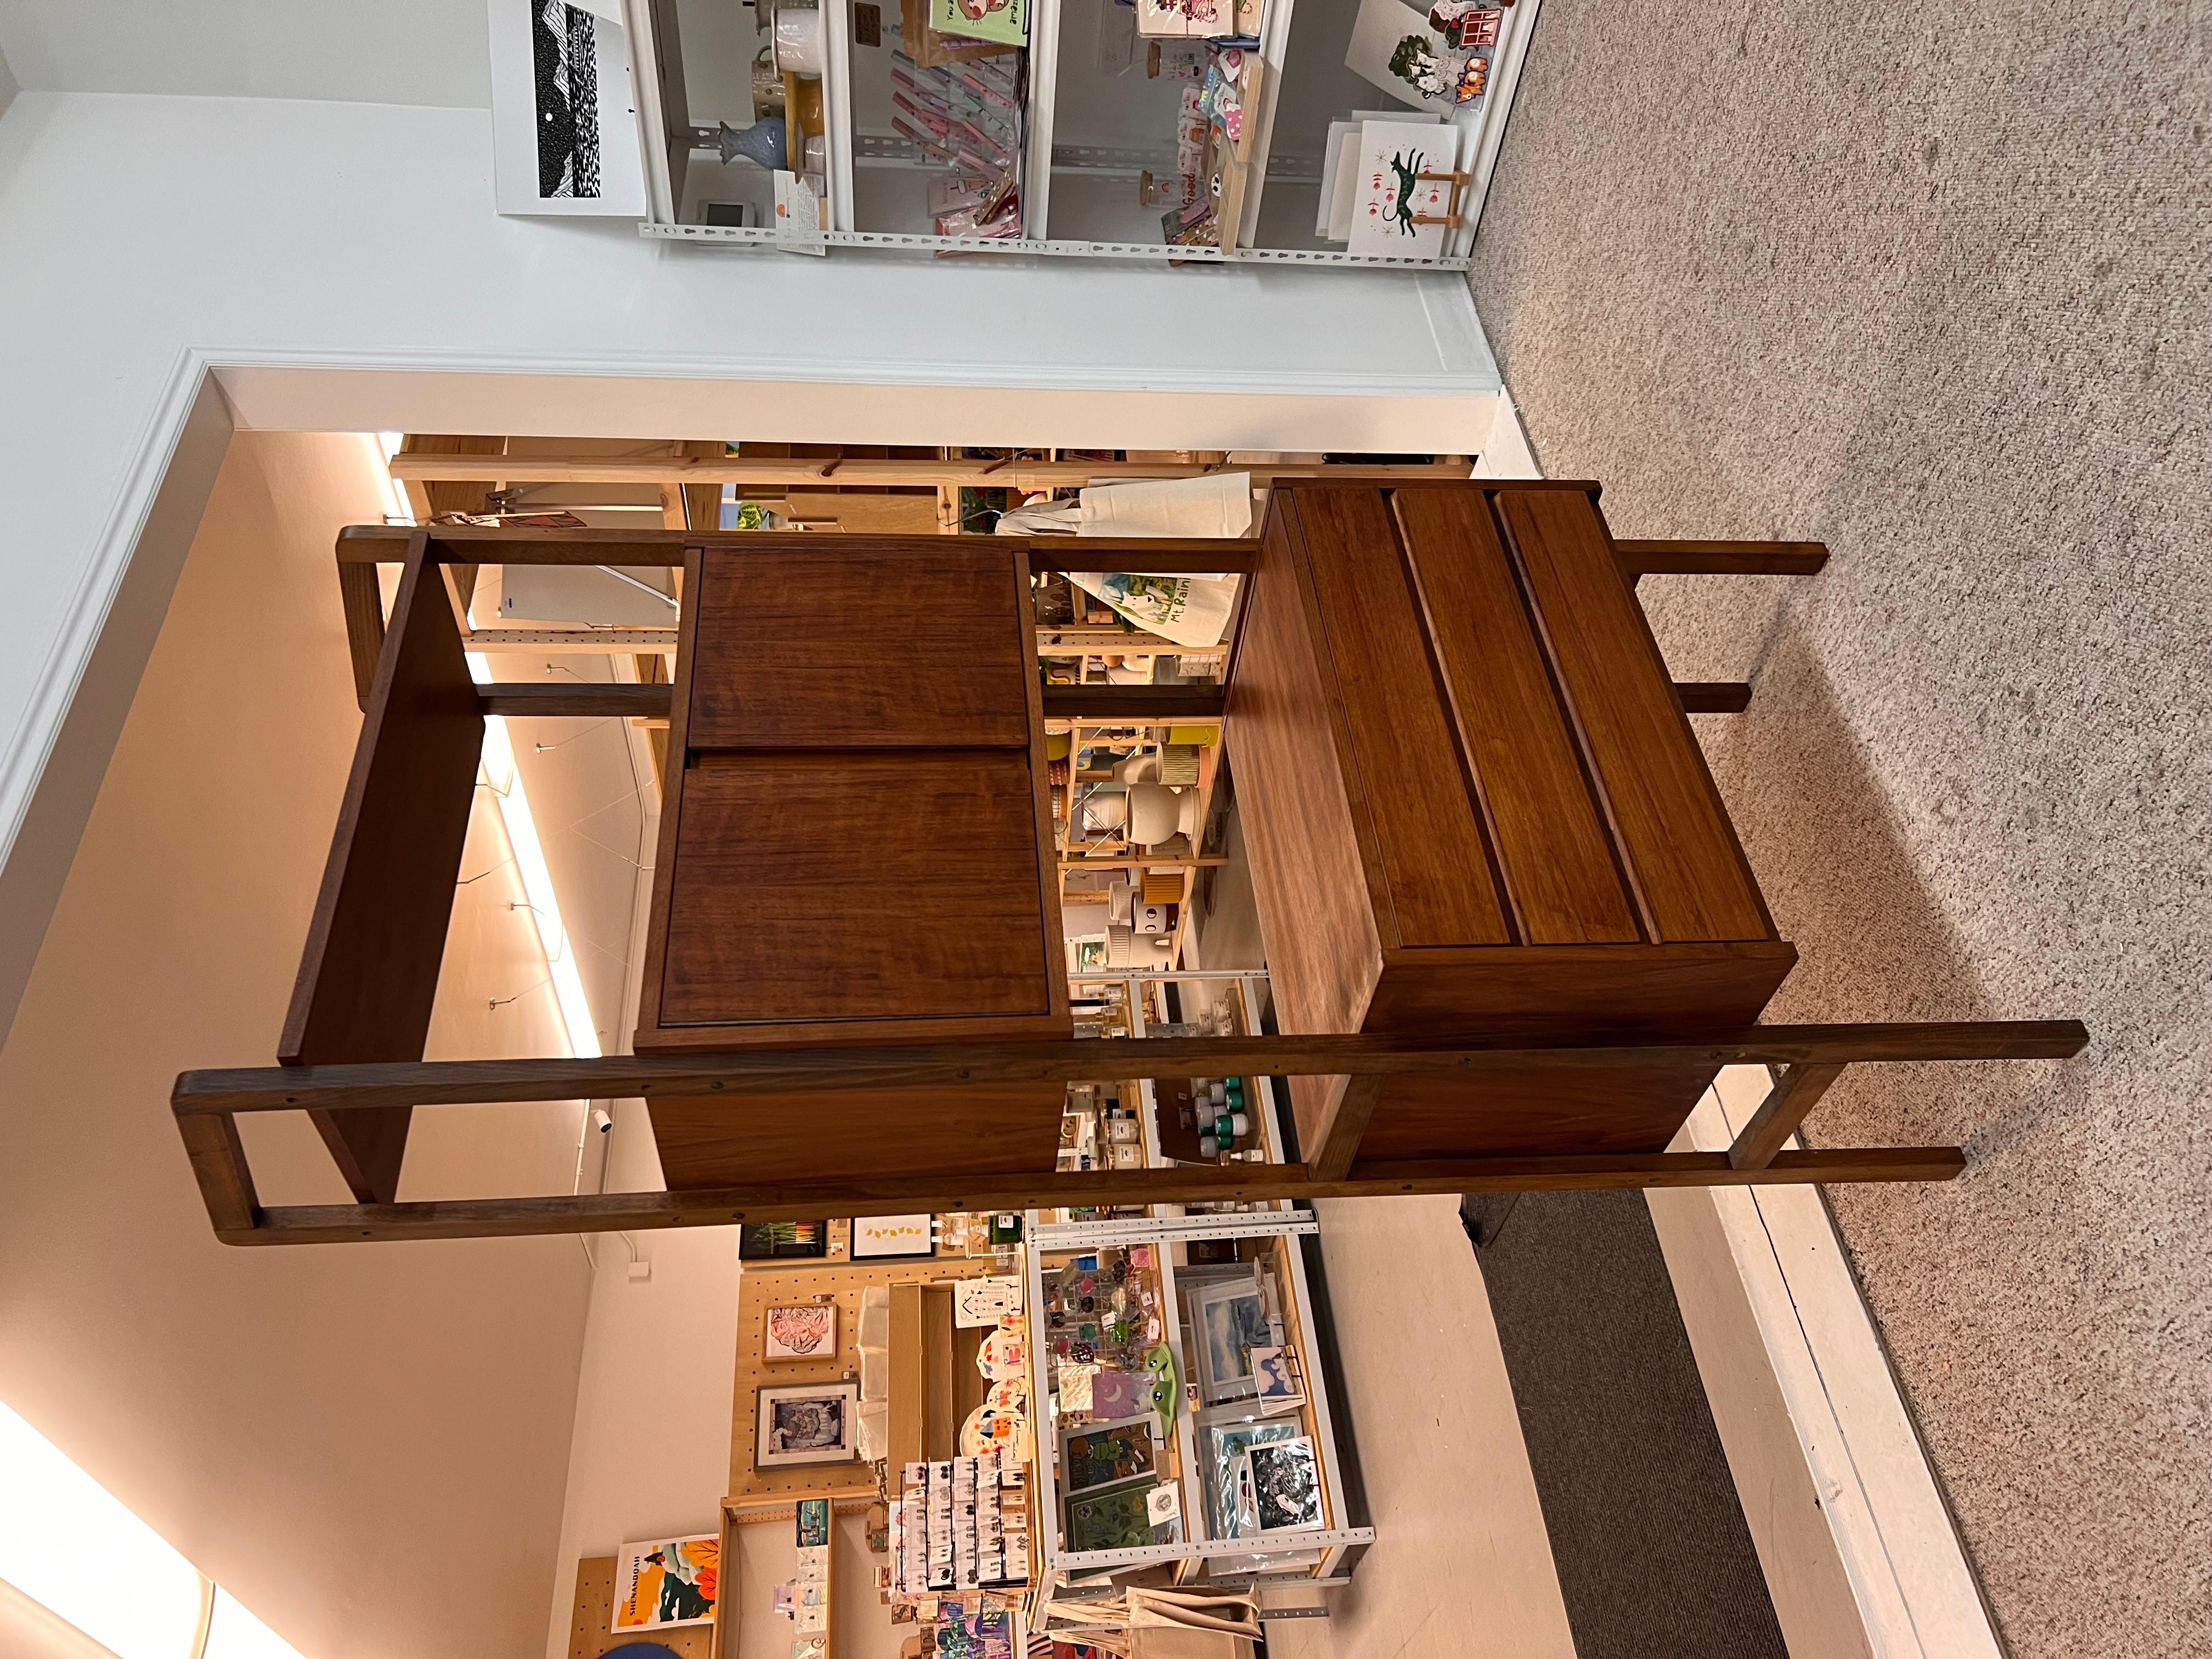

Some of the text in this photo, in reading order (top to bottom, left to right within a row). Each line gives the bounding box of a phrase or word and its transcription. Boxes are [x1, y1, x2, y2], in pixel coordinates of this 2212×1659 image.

[1182, 173, 1195, 205] Good
[1170, 608, 1184, 623] Mt.
[629, 1556, 640, 1616] SHENANDOAH
